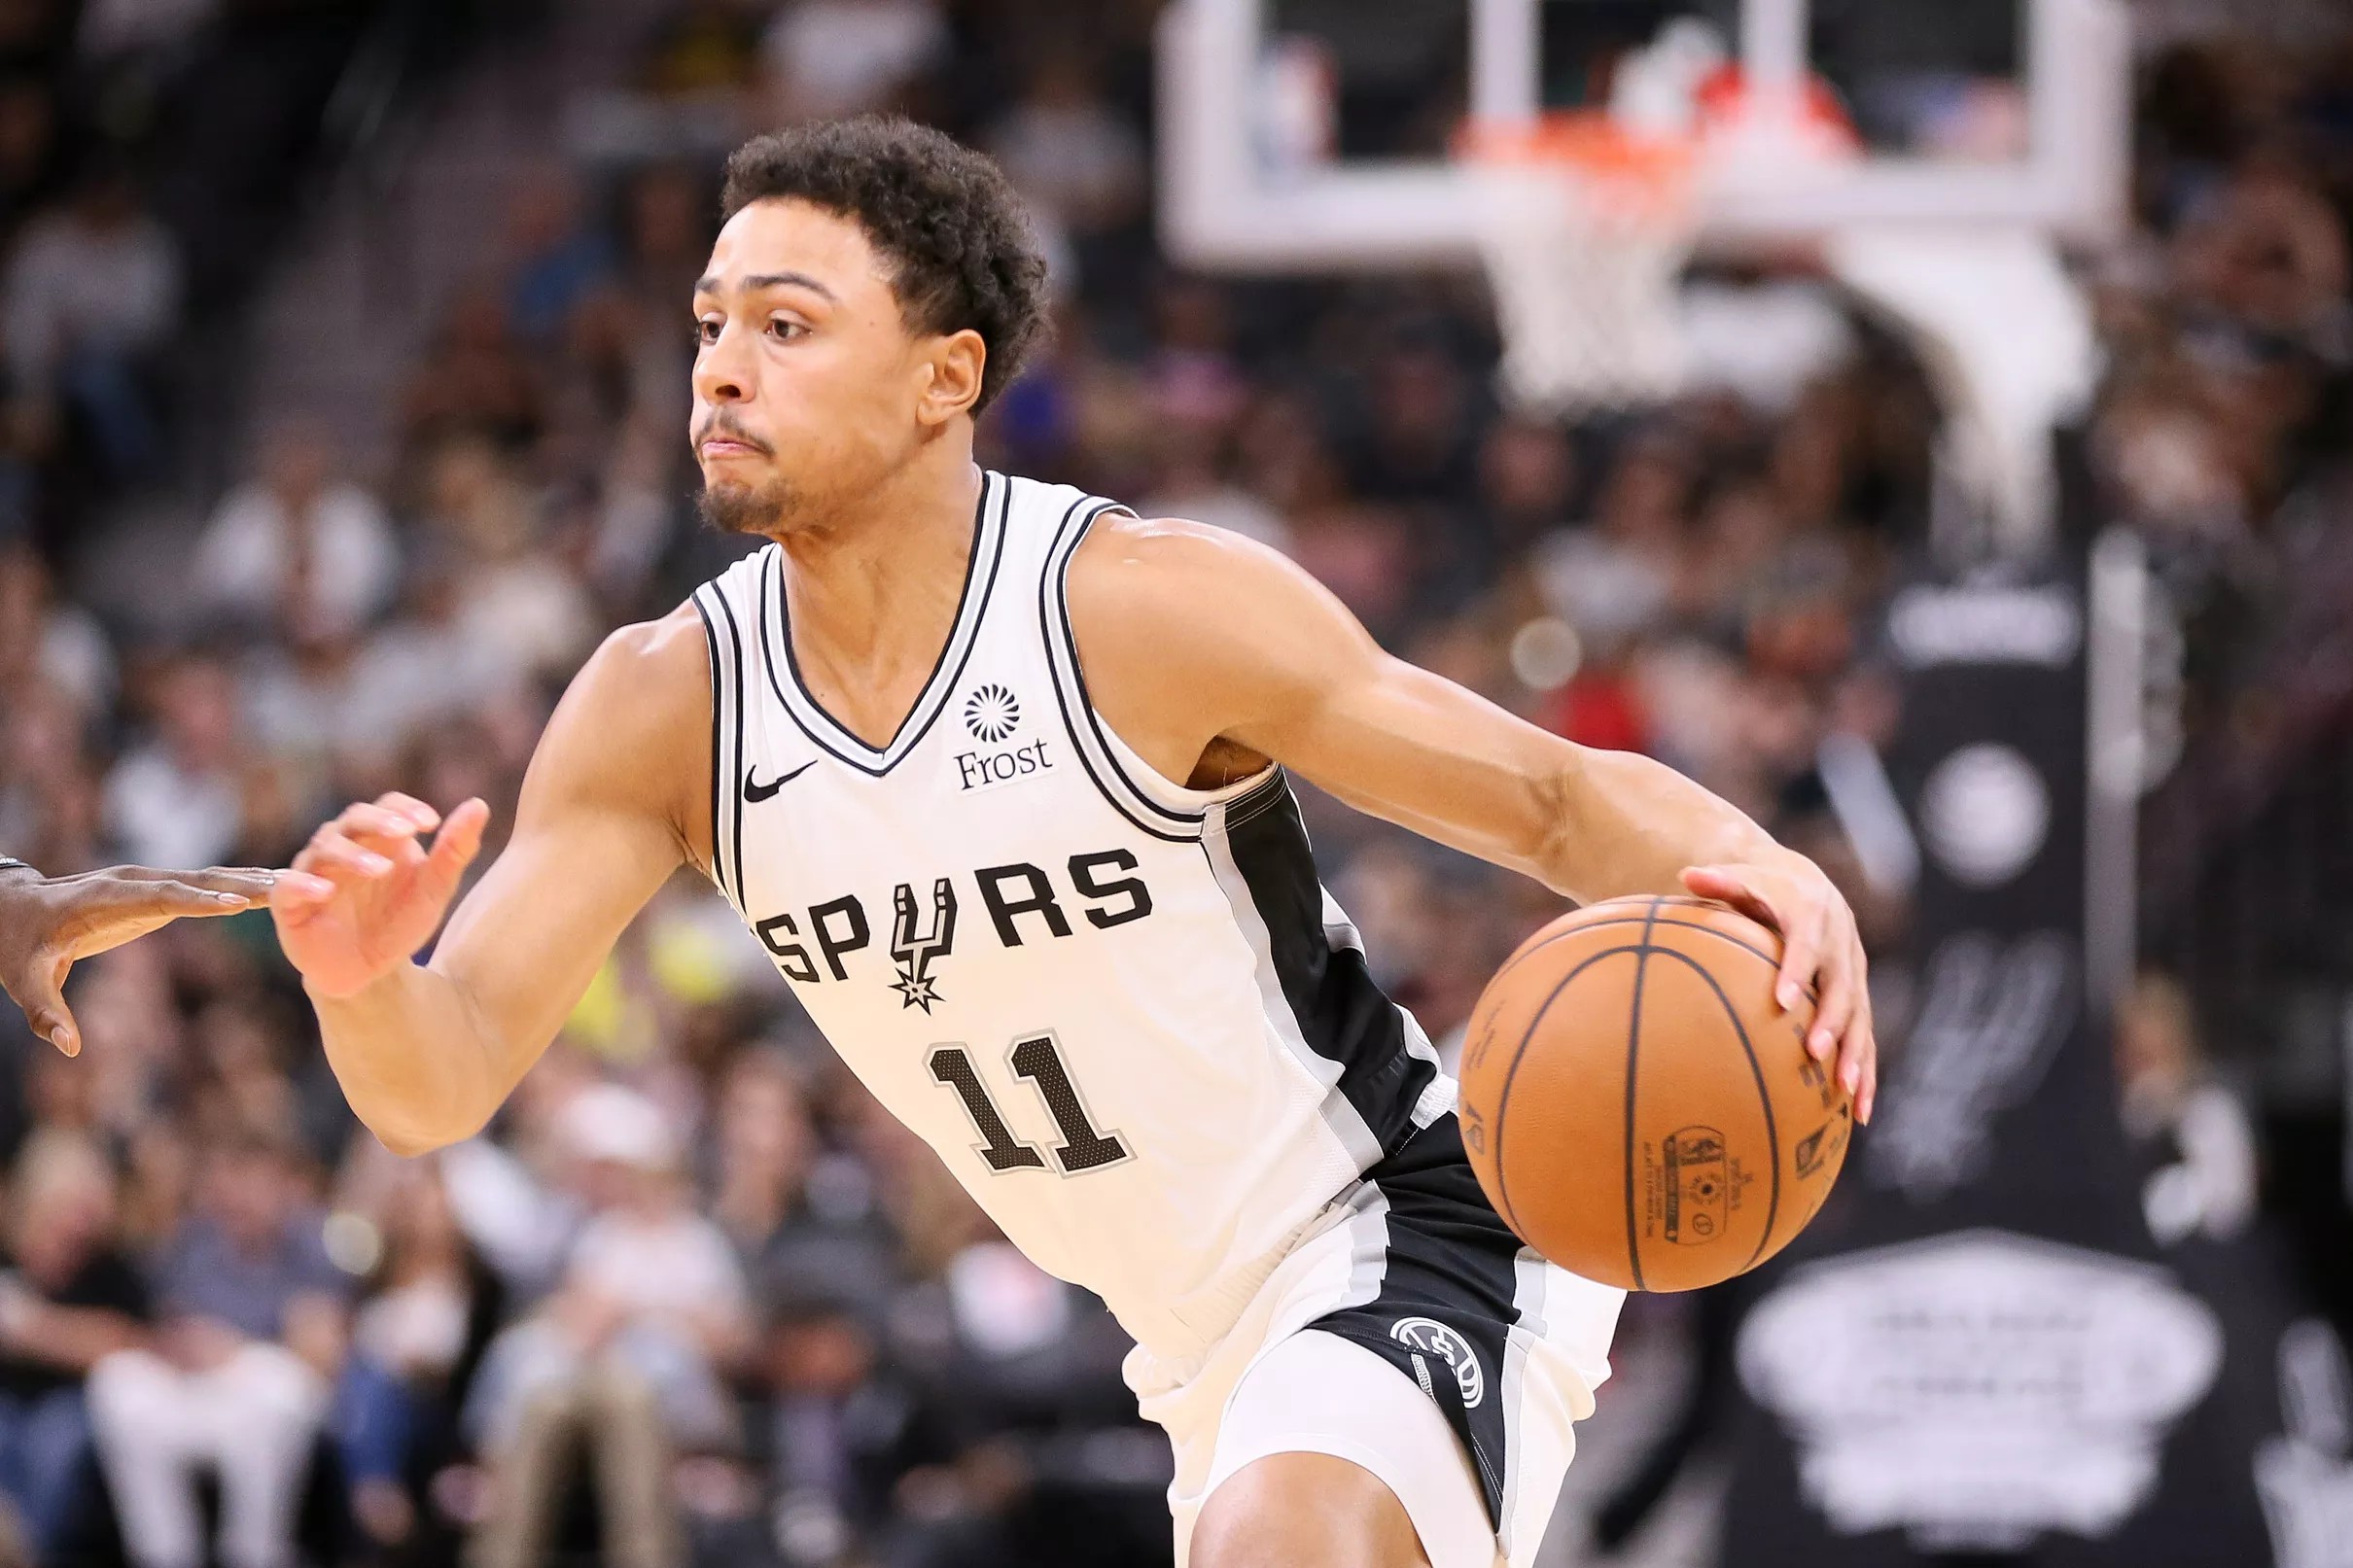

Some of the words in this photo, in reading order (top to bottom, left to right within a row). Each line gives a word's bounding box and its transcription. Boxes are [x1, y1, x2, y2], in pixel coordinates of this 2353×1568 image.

[953, 736, 1054, 791] Frost
[755, 847, 1153, 1016] SPURS
[922, 1028, 1139, 1179] 11
